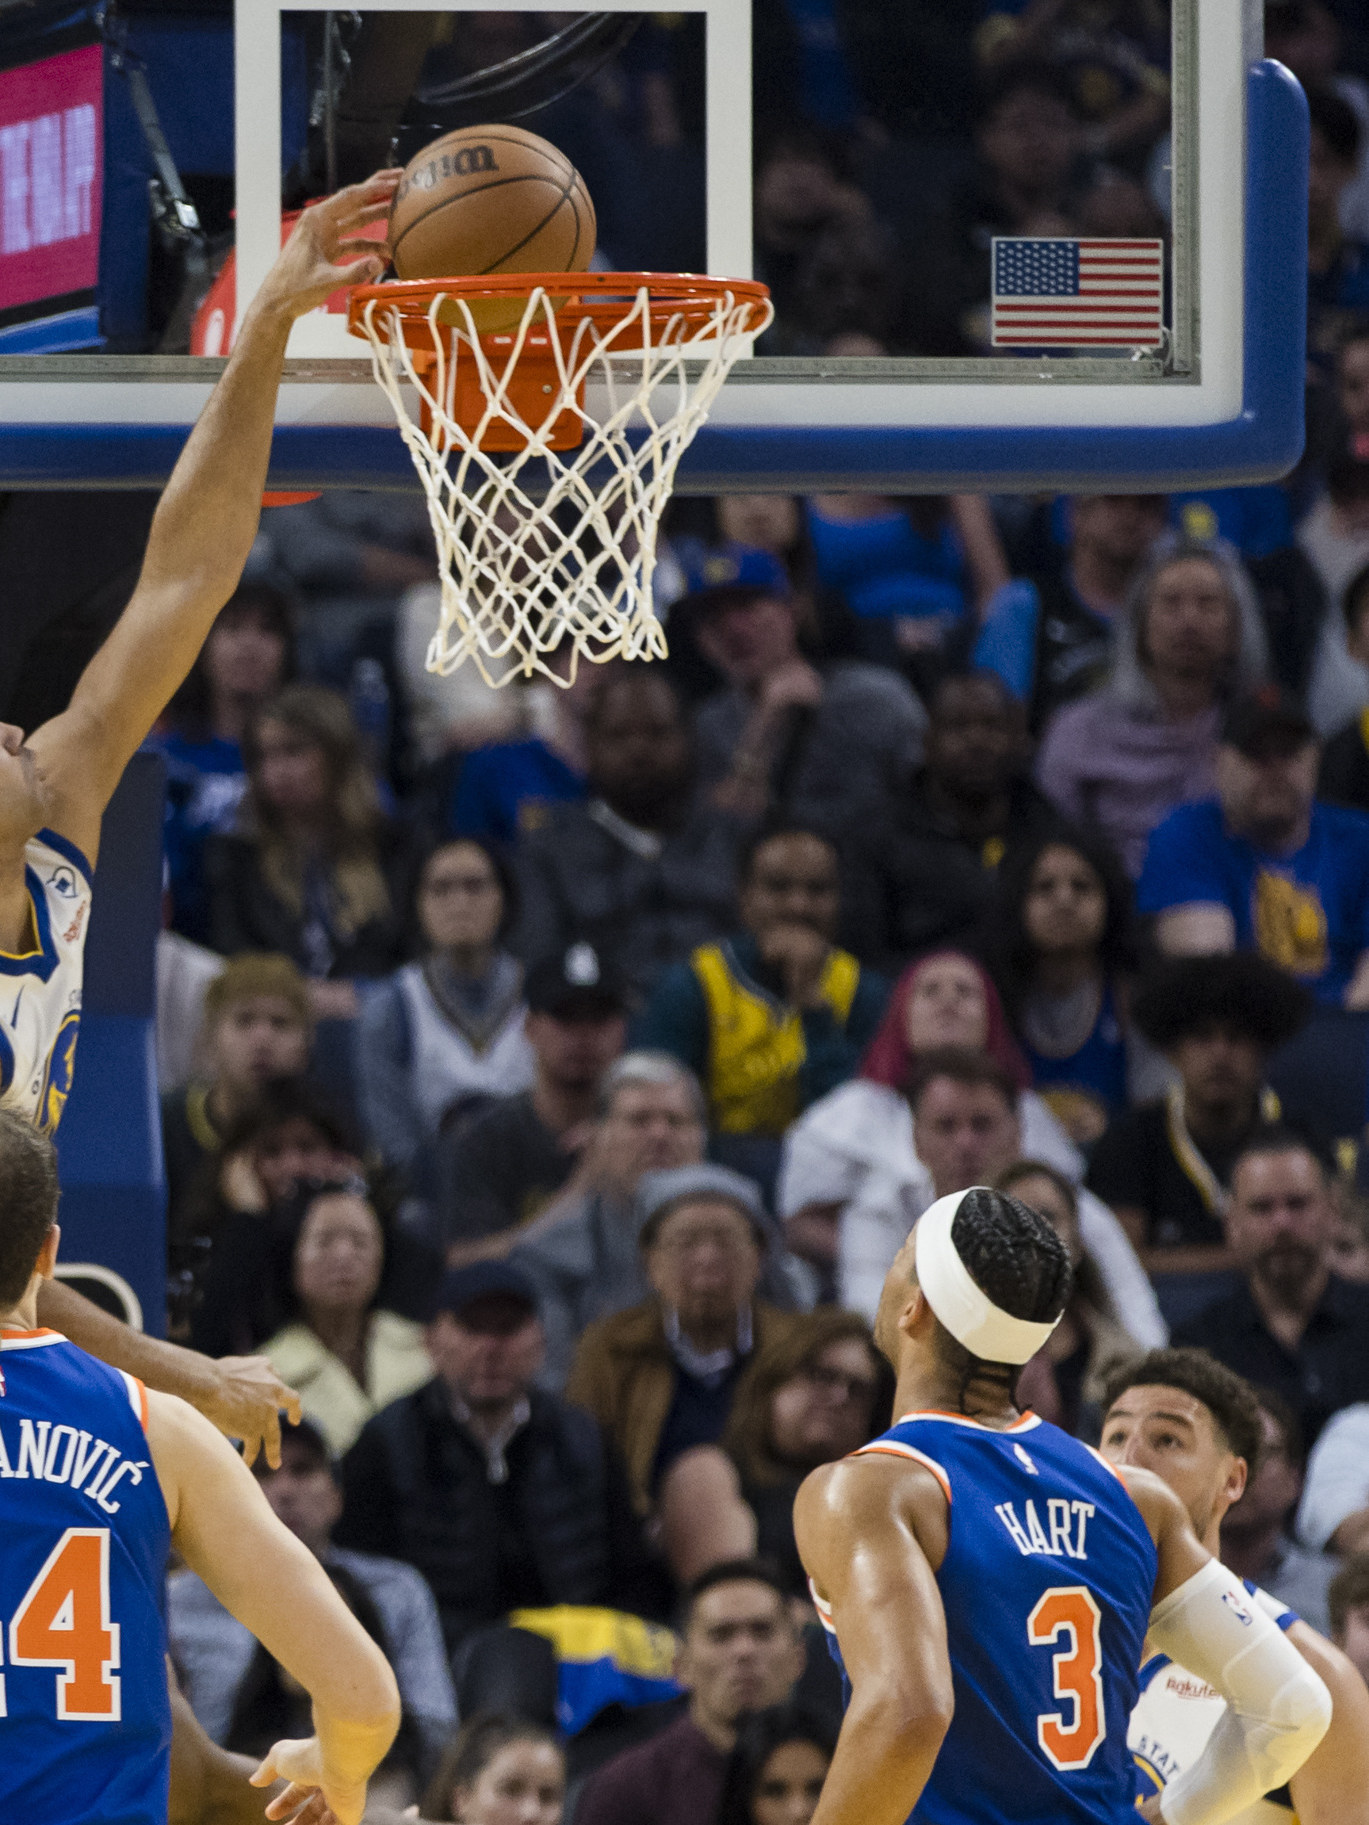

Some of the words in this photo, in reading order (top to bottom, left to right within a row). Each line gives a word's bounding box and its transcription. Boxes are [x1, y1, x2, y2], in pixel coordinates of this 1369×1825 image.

[994, 1498, 1096, 1560] HART
[1027, 1586, 1106, 1771] 3
[1165, 1676, 1222, 1700] Rakute
